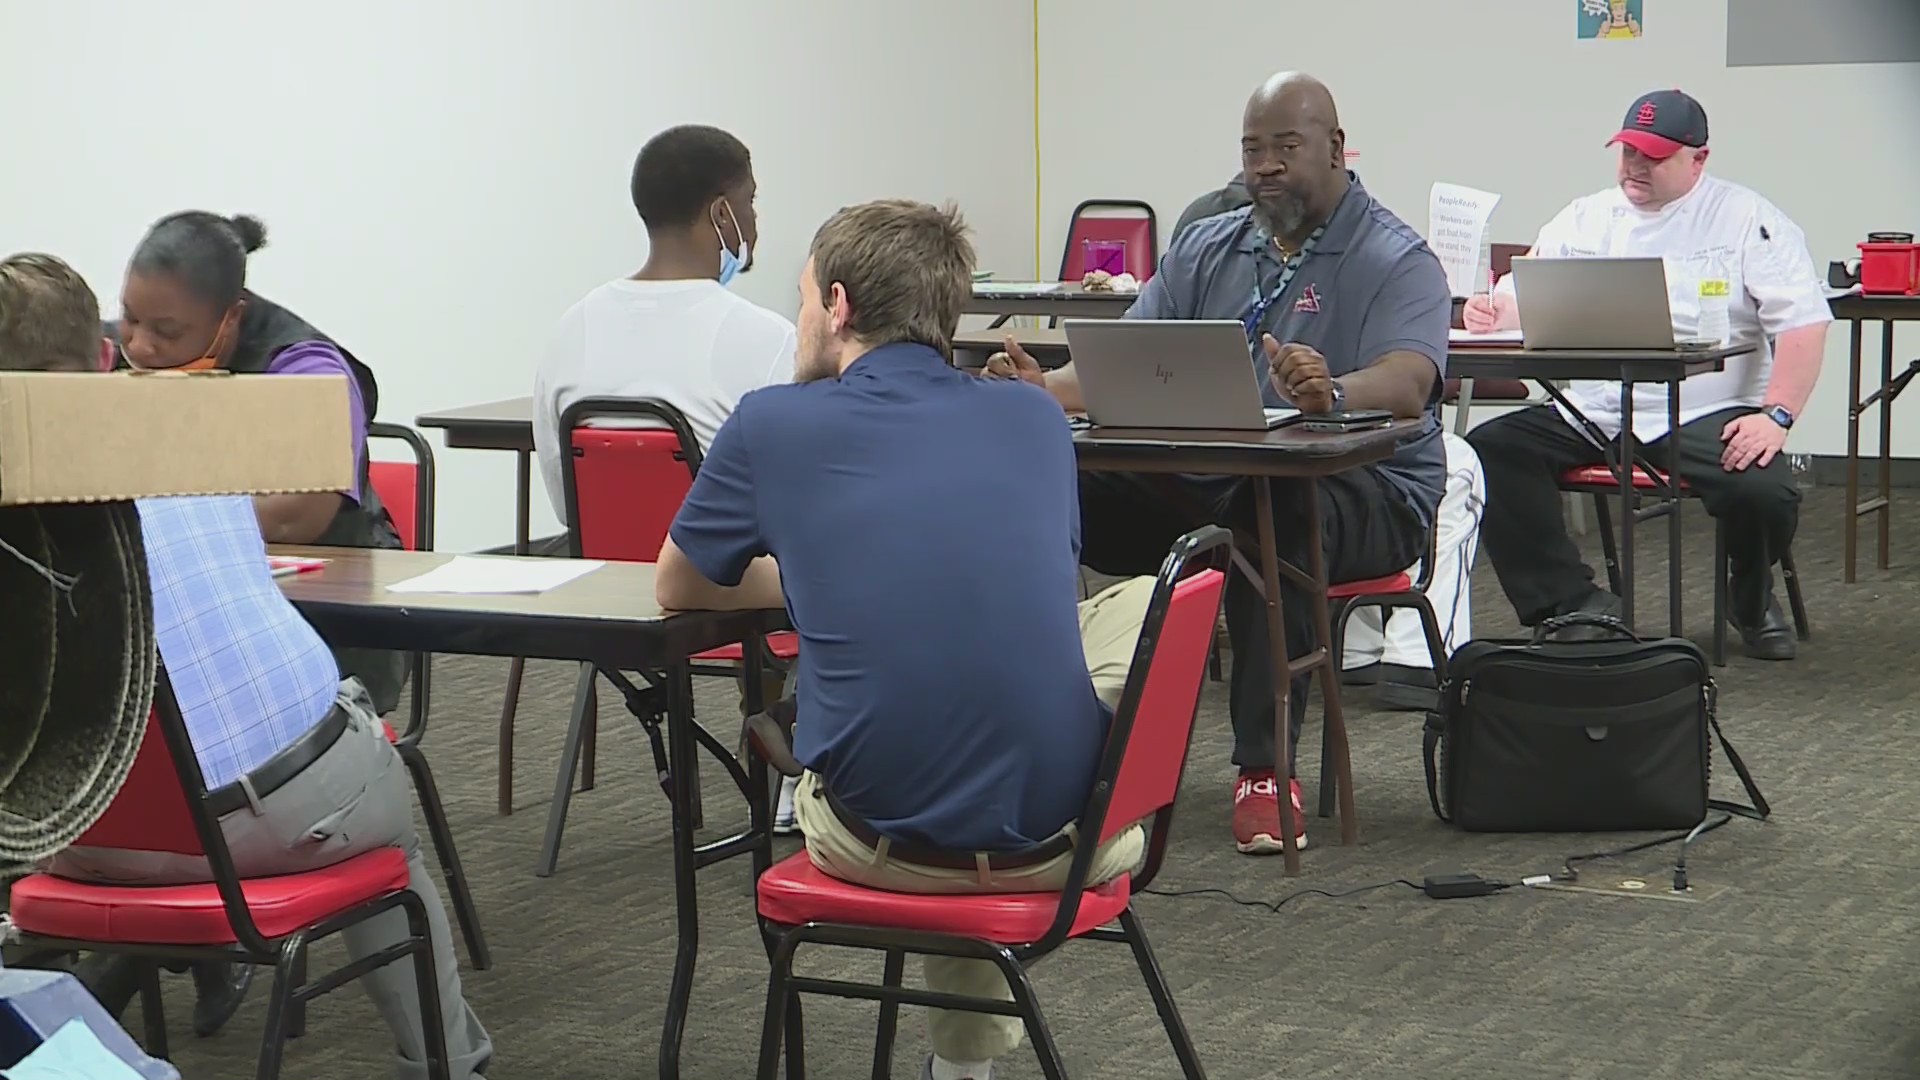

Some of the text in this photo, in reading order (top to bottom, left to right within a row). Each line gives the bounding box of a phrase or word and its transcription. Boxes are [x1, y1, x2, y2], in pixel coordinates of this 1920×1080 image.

[1440, 214, 1473, 226] Workers can
[1156, 363, 1173, 385] hp
